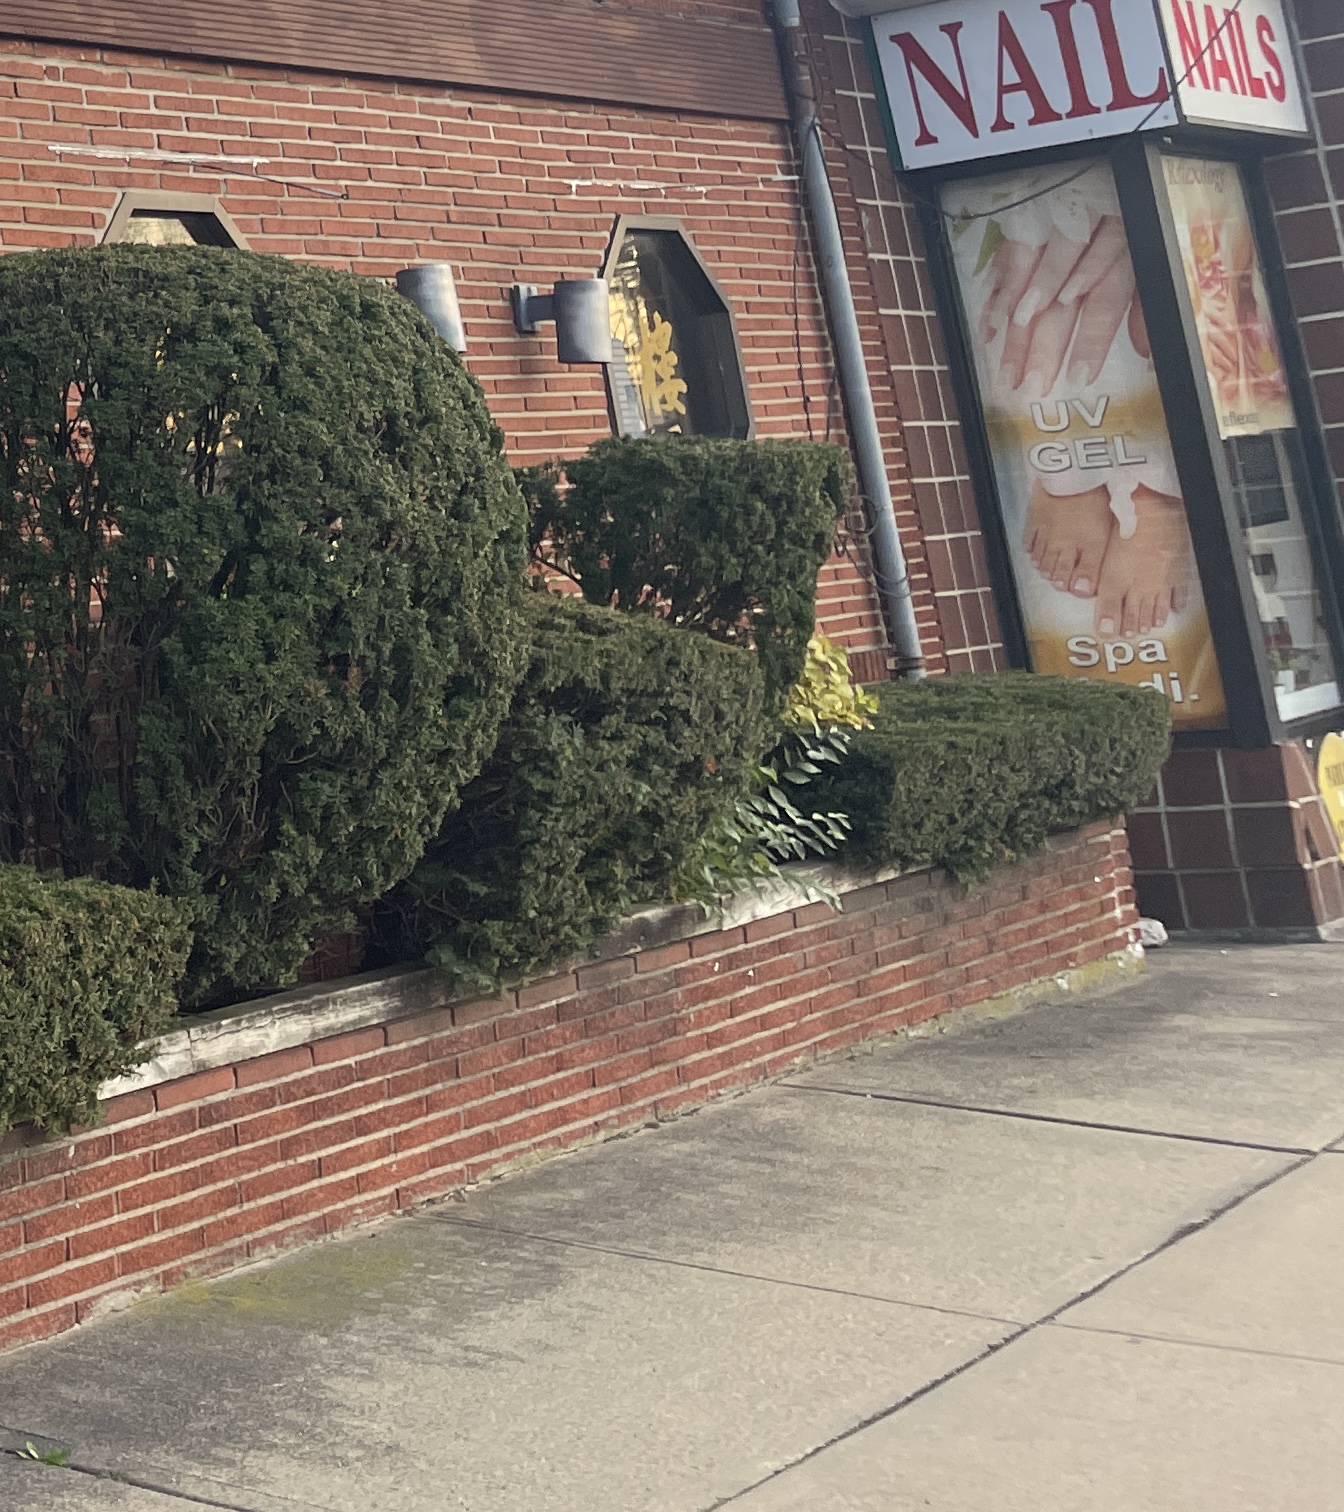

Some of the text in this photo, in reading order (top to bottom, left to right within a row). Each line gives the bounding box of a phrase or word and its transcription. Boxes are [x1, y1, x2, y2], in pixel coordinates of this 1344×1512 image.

[1030, 395, 1109, 432] UV
[1029, 435, 1147, 473] GEL
[1067, 637, 1168, 672] Spa
